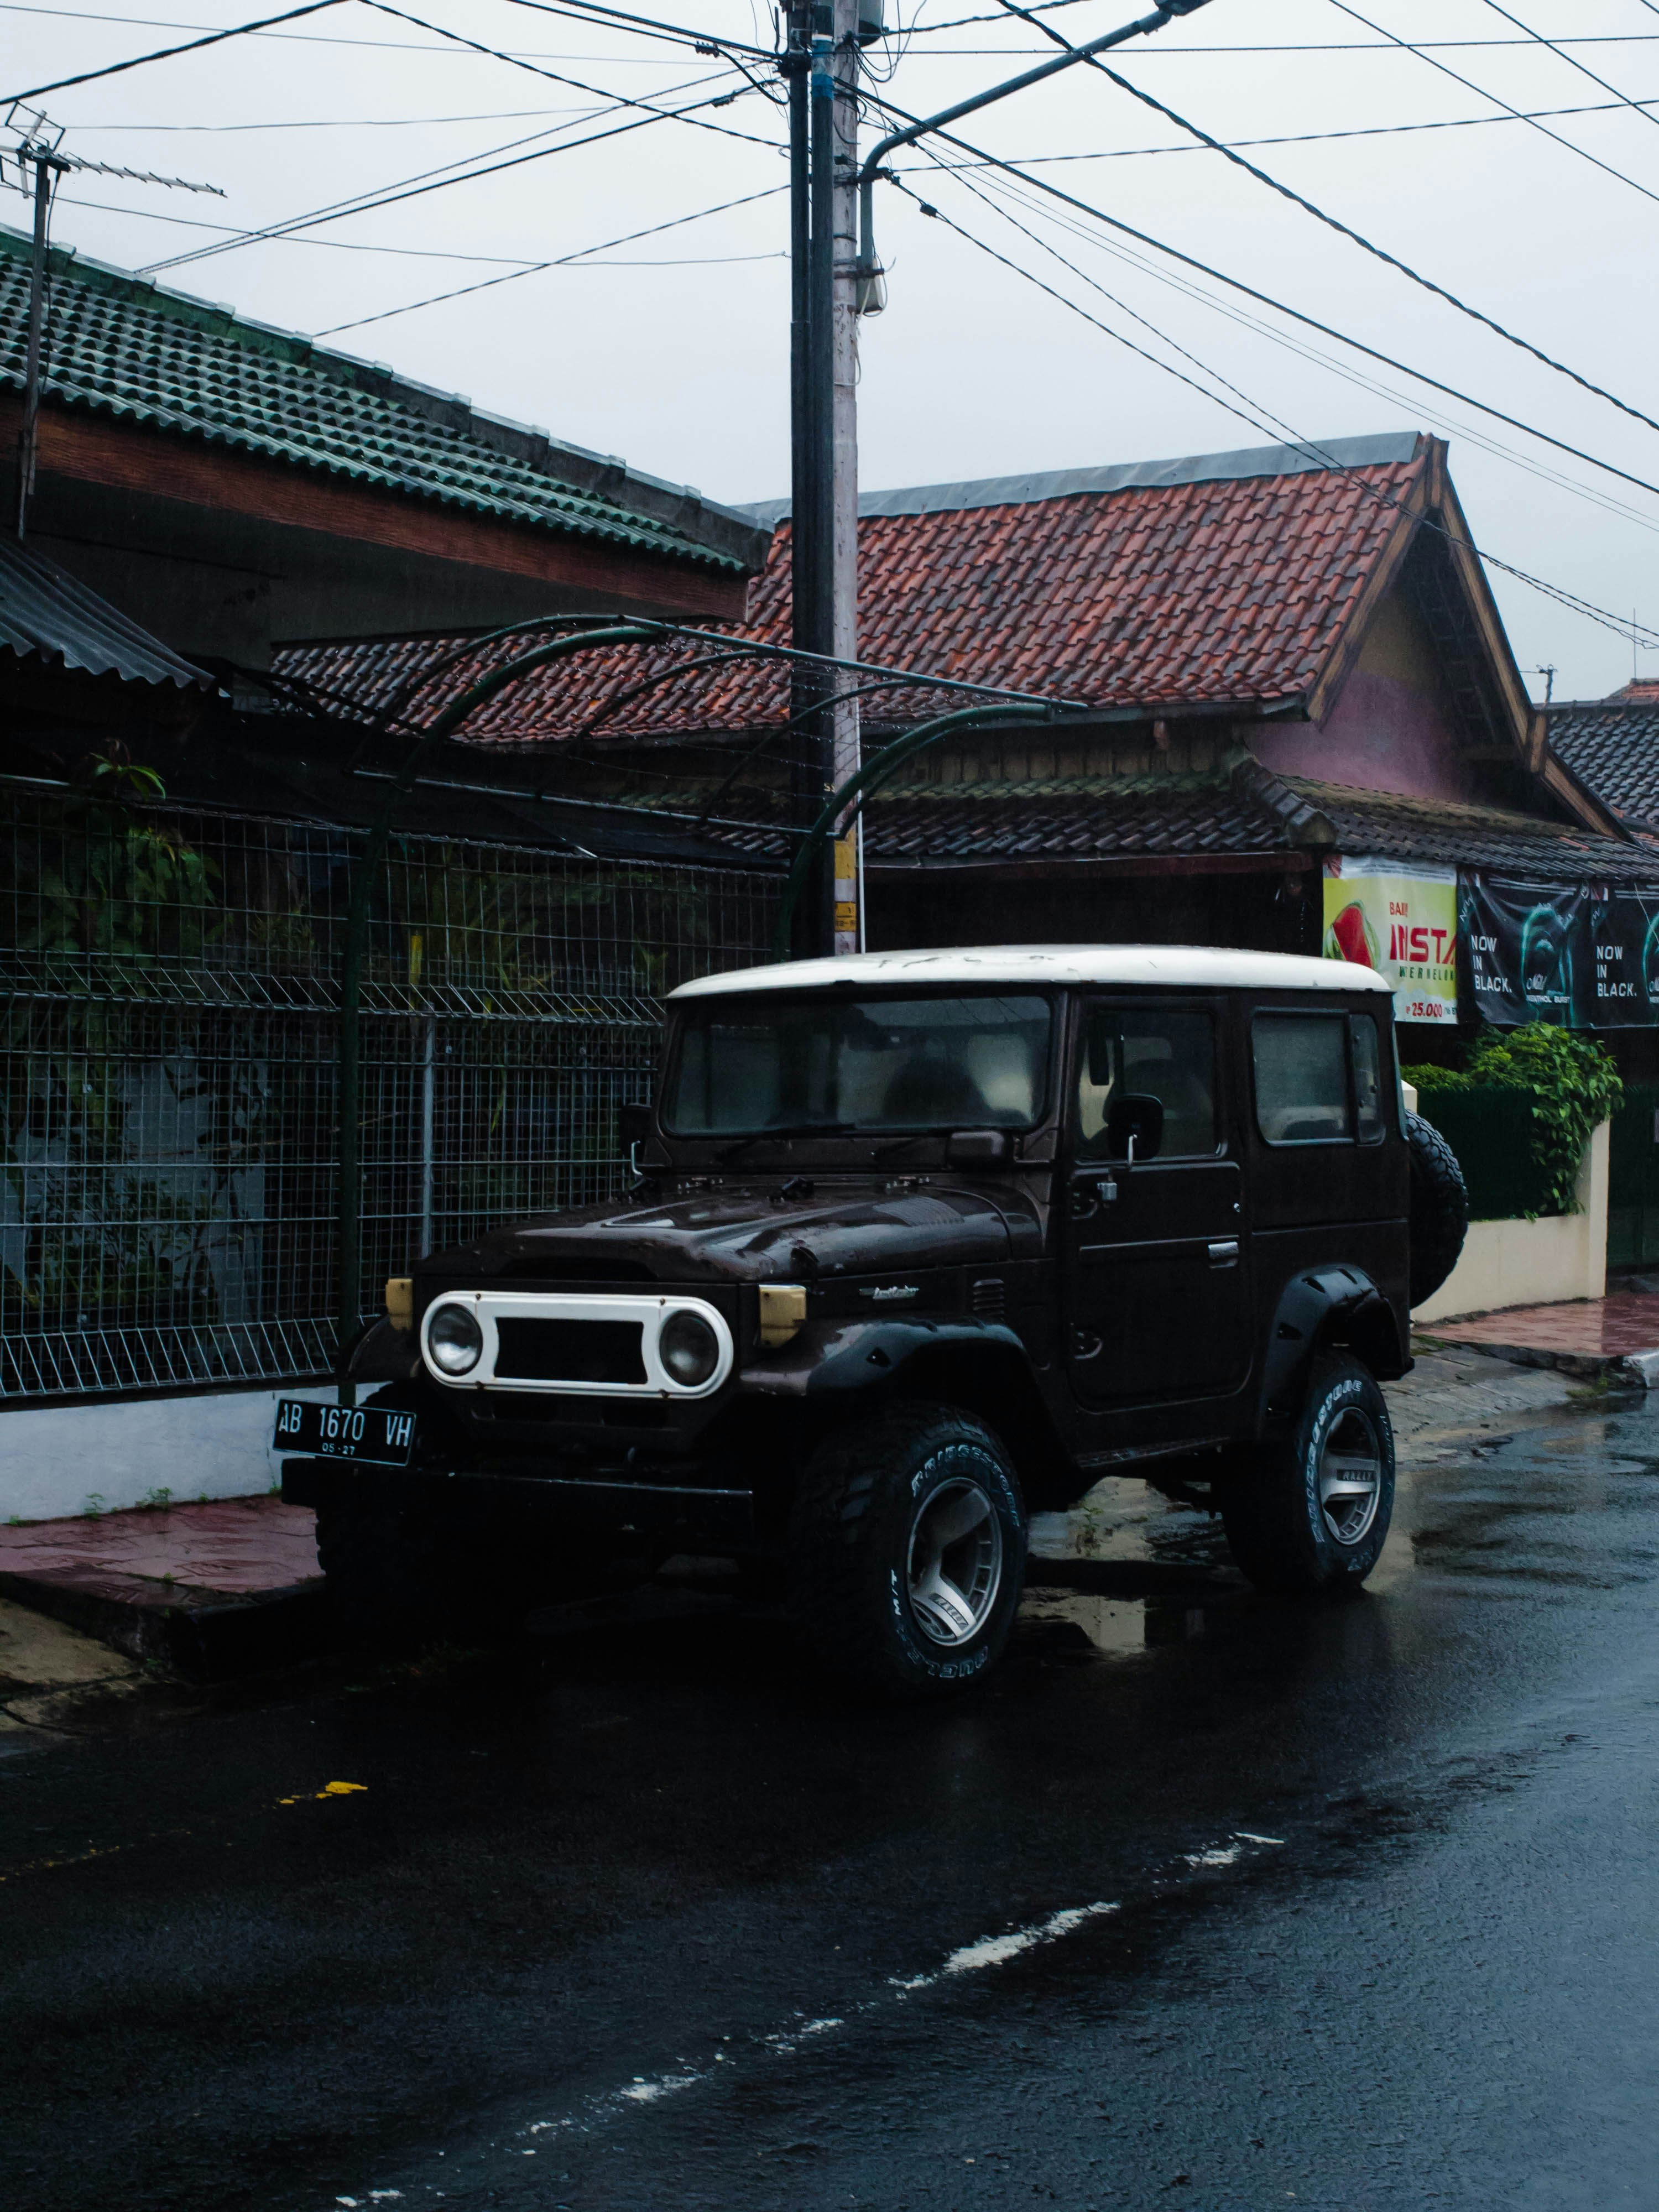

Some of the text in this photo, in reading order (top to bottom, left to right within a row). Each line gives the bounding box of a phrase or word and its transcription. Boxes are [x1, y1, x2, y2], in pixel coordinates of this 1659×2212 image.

[1470, 935, 1498, 952] NOW
[1596, 946, 1623, 960] NOW
[1473, 955, 1483, 971] IN
[1597, 964, 1607, 978] IN
[1474, 975, 1512, 993] BLACK.
[1597, 983, 1637, 998] BLACK.
[279, 1403, 411, 1447] AB 1670 VH
